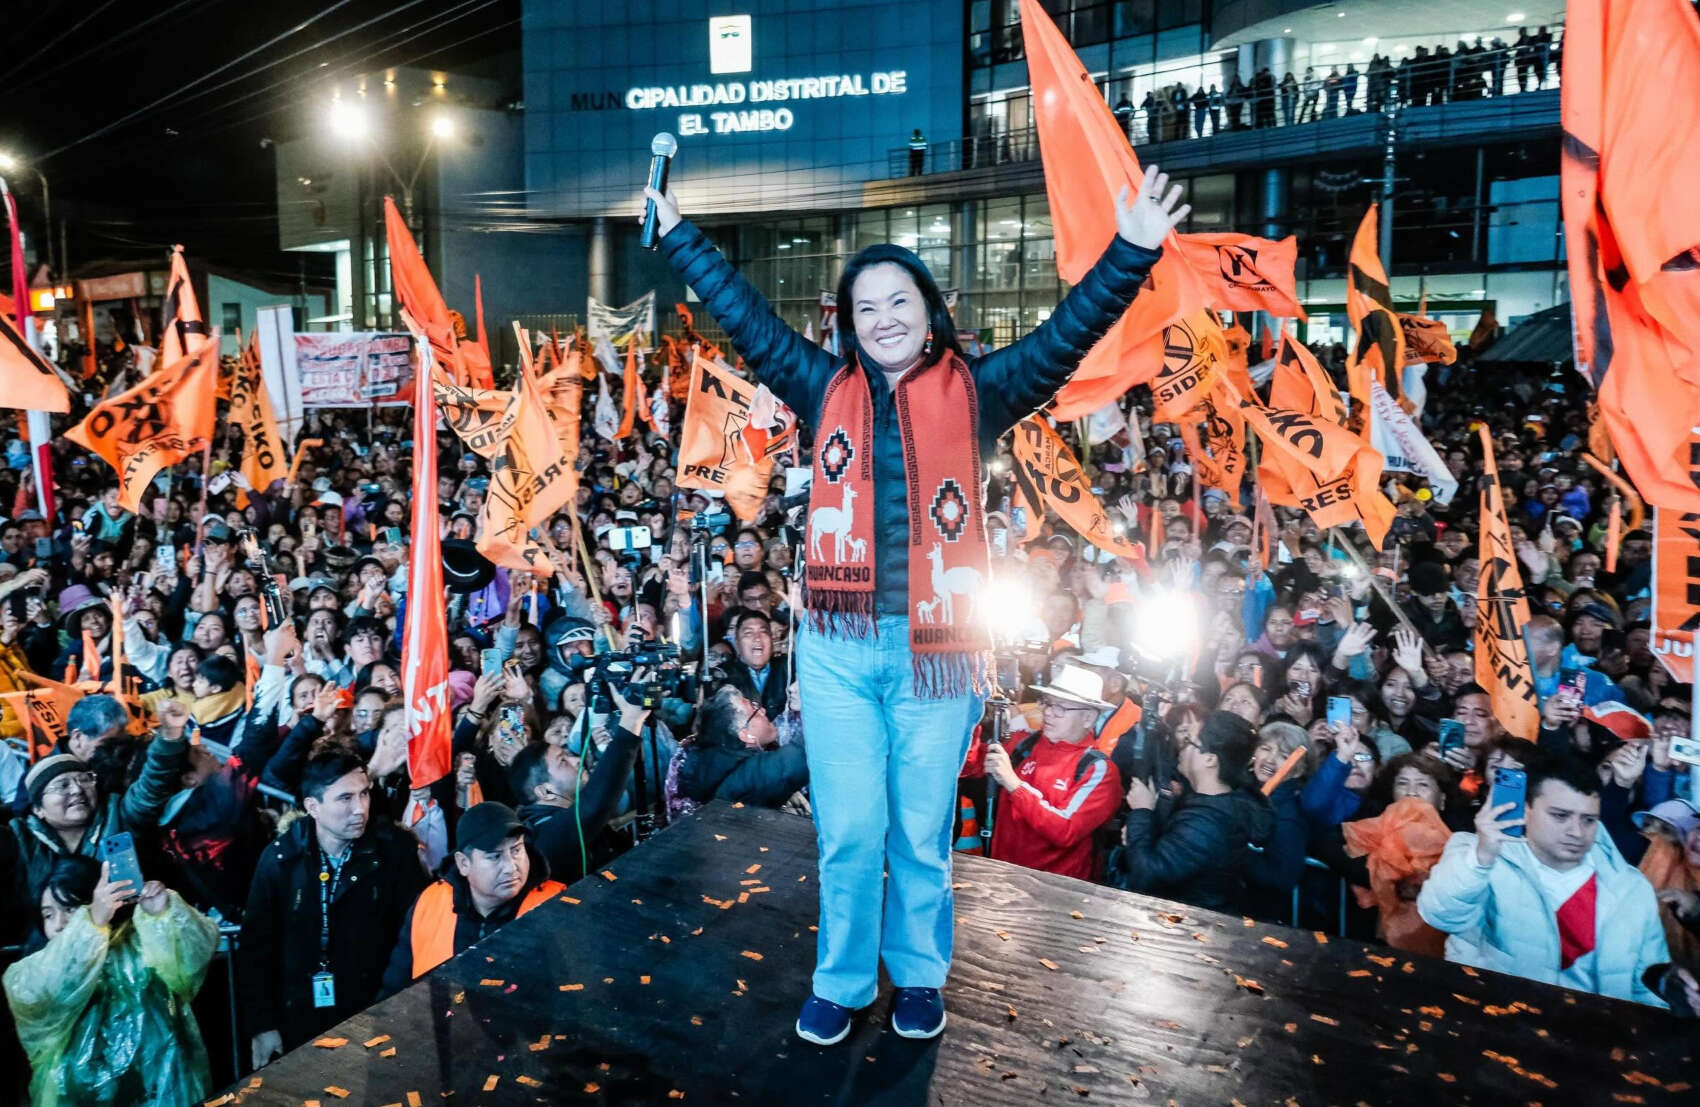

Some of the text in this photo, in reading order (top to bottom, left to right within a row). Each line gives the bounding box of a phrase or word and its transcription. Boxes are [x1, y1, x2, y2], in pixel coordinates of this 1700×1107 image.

[749, 74, 870, 102] DISTRITAL
[871, 70, 908, 94] DE
[678, 107, 795, 136] EL TAMBO
[807, 565, 870, 583] HUANCAYO
